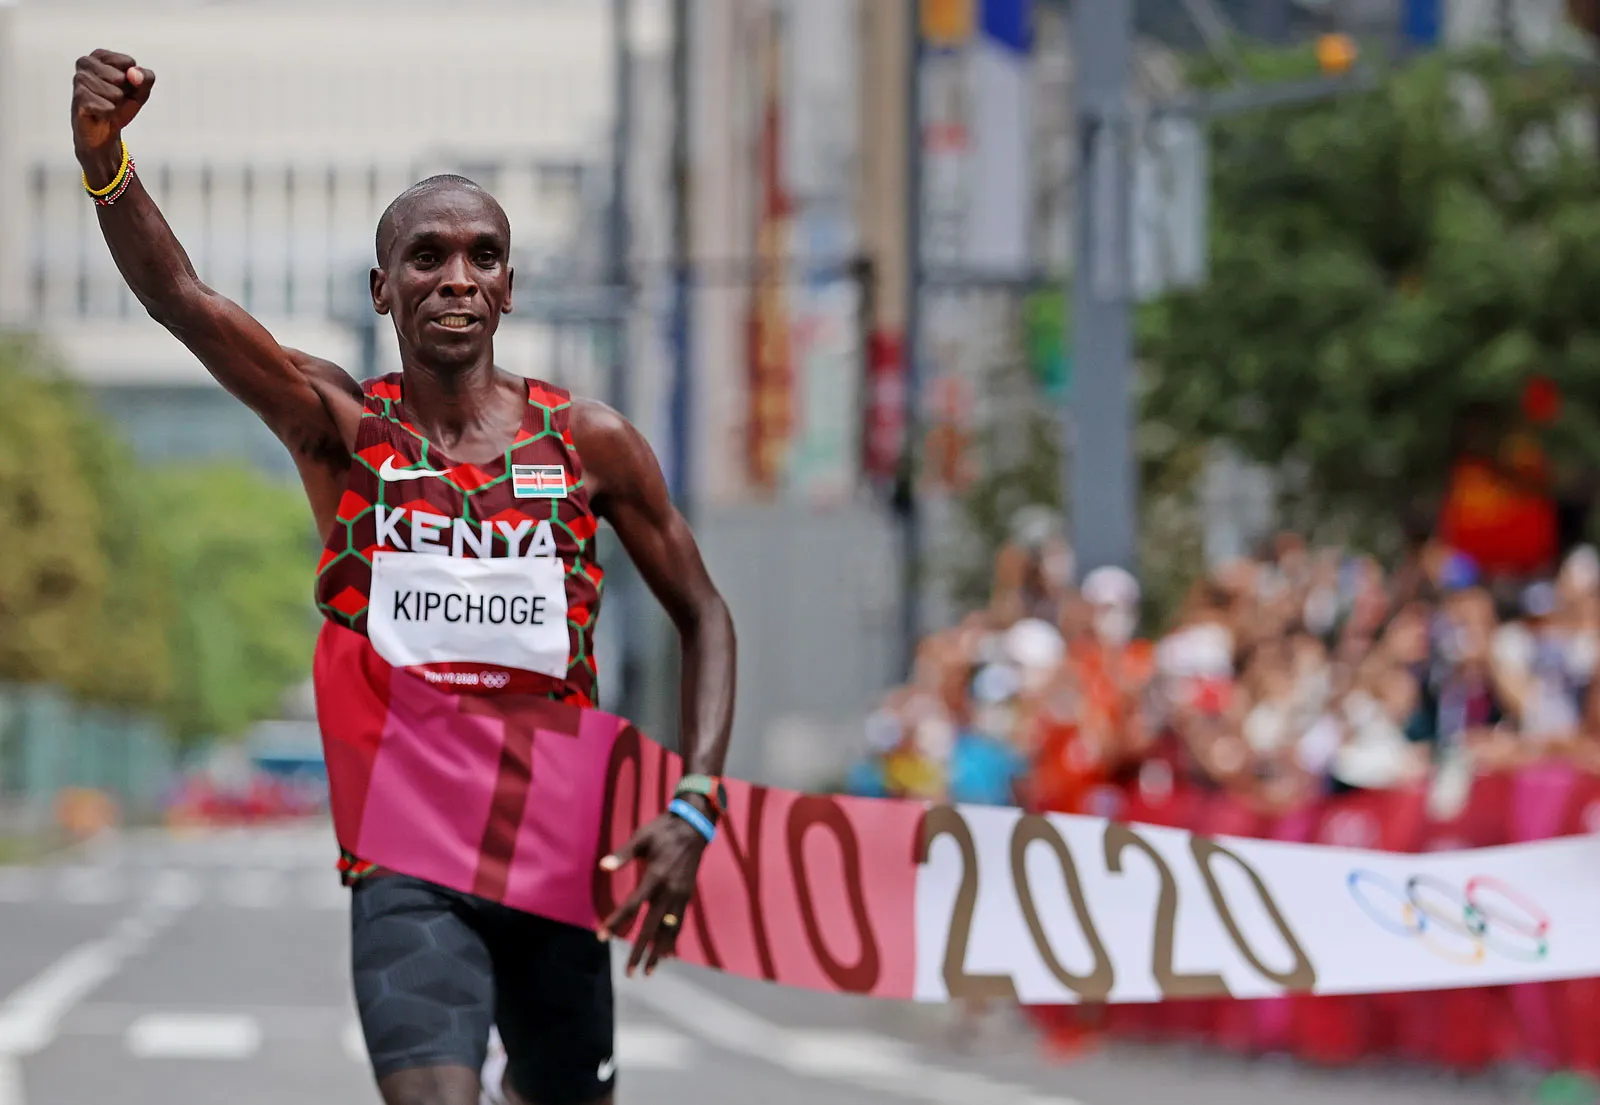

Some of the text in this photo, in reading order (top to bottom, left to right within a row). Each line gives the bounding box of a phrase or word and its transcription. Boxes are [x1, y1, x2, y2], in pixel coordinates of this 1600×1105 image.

[374, 503, 558, 559] KENYA
[393, 590, 546, 625] KIPCHOGE
[911, 804, 1317, 1004] 2020
